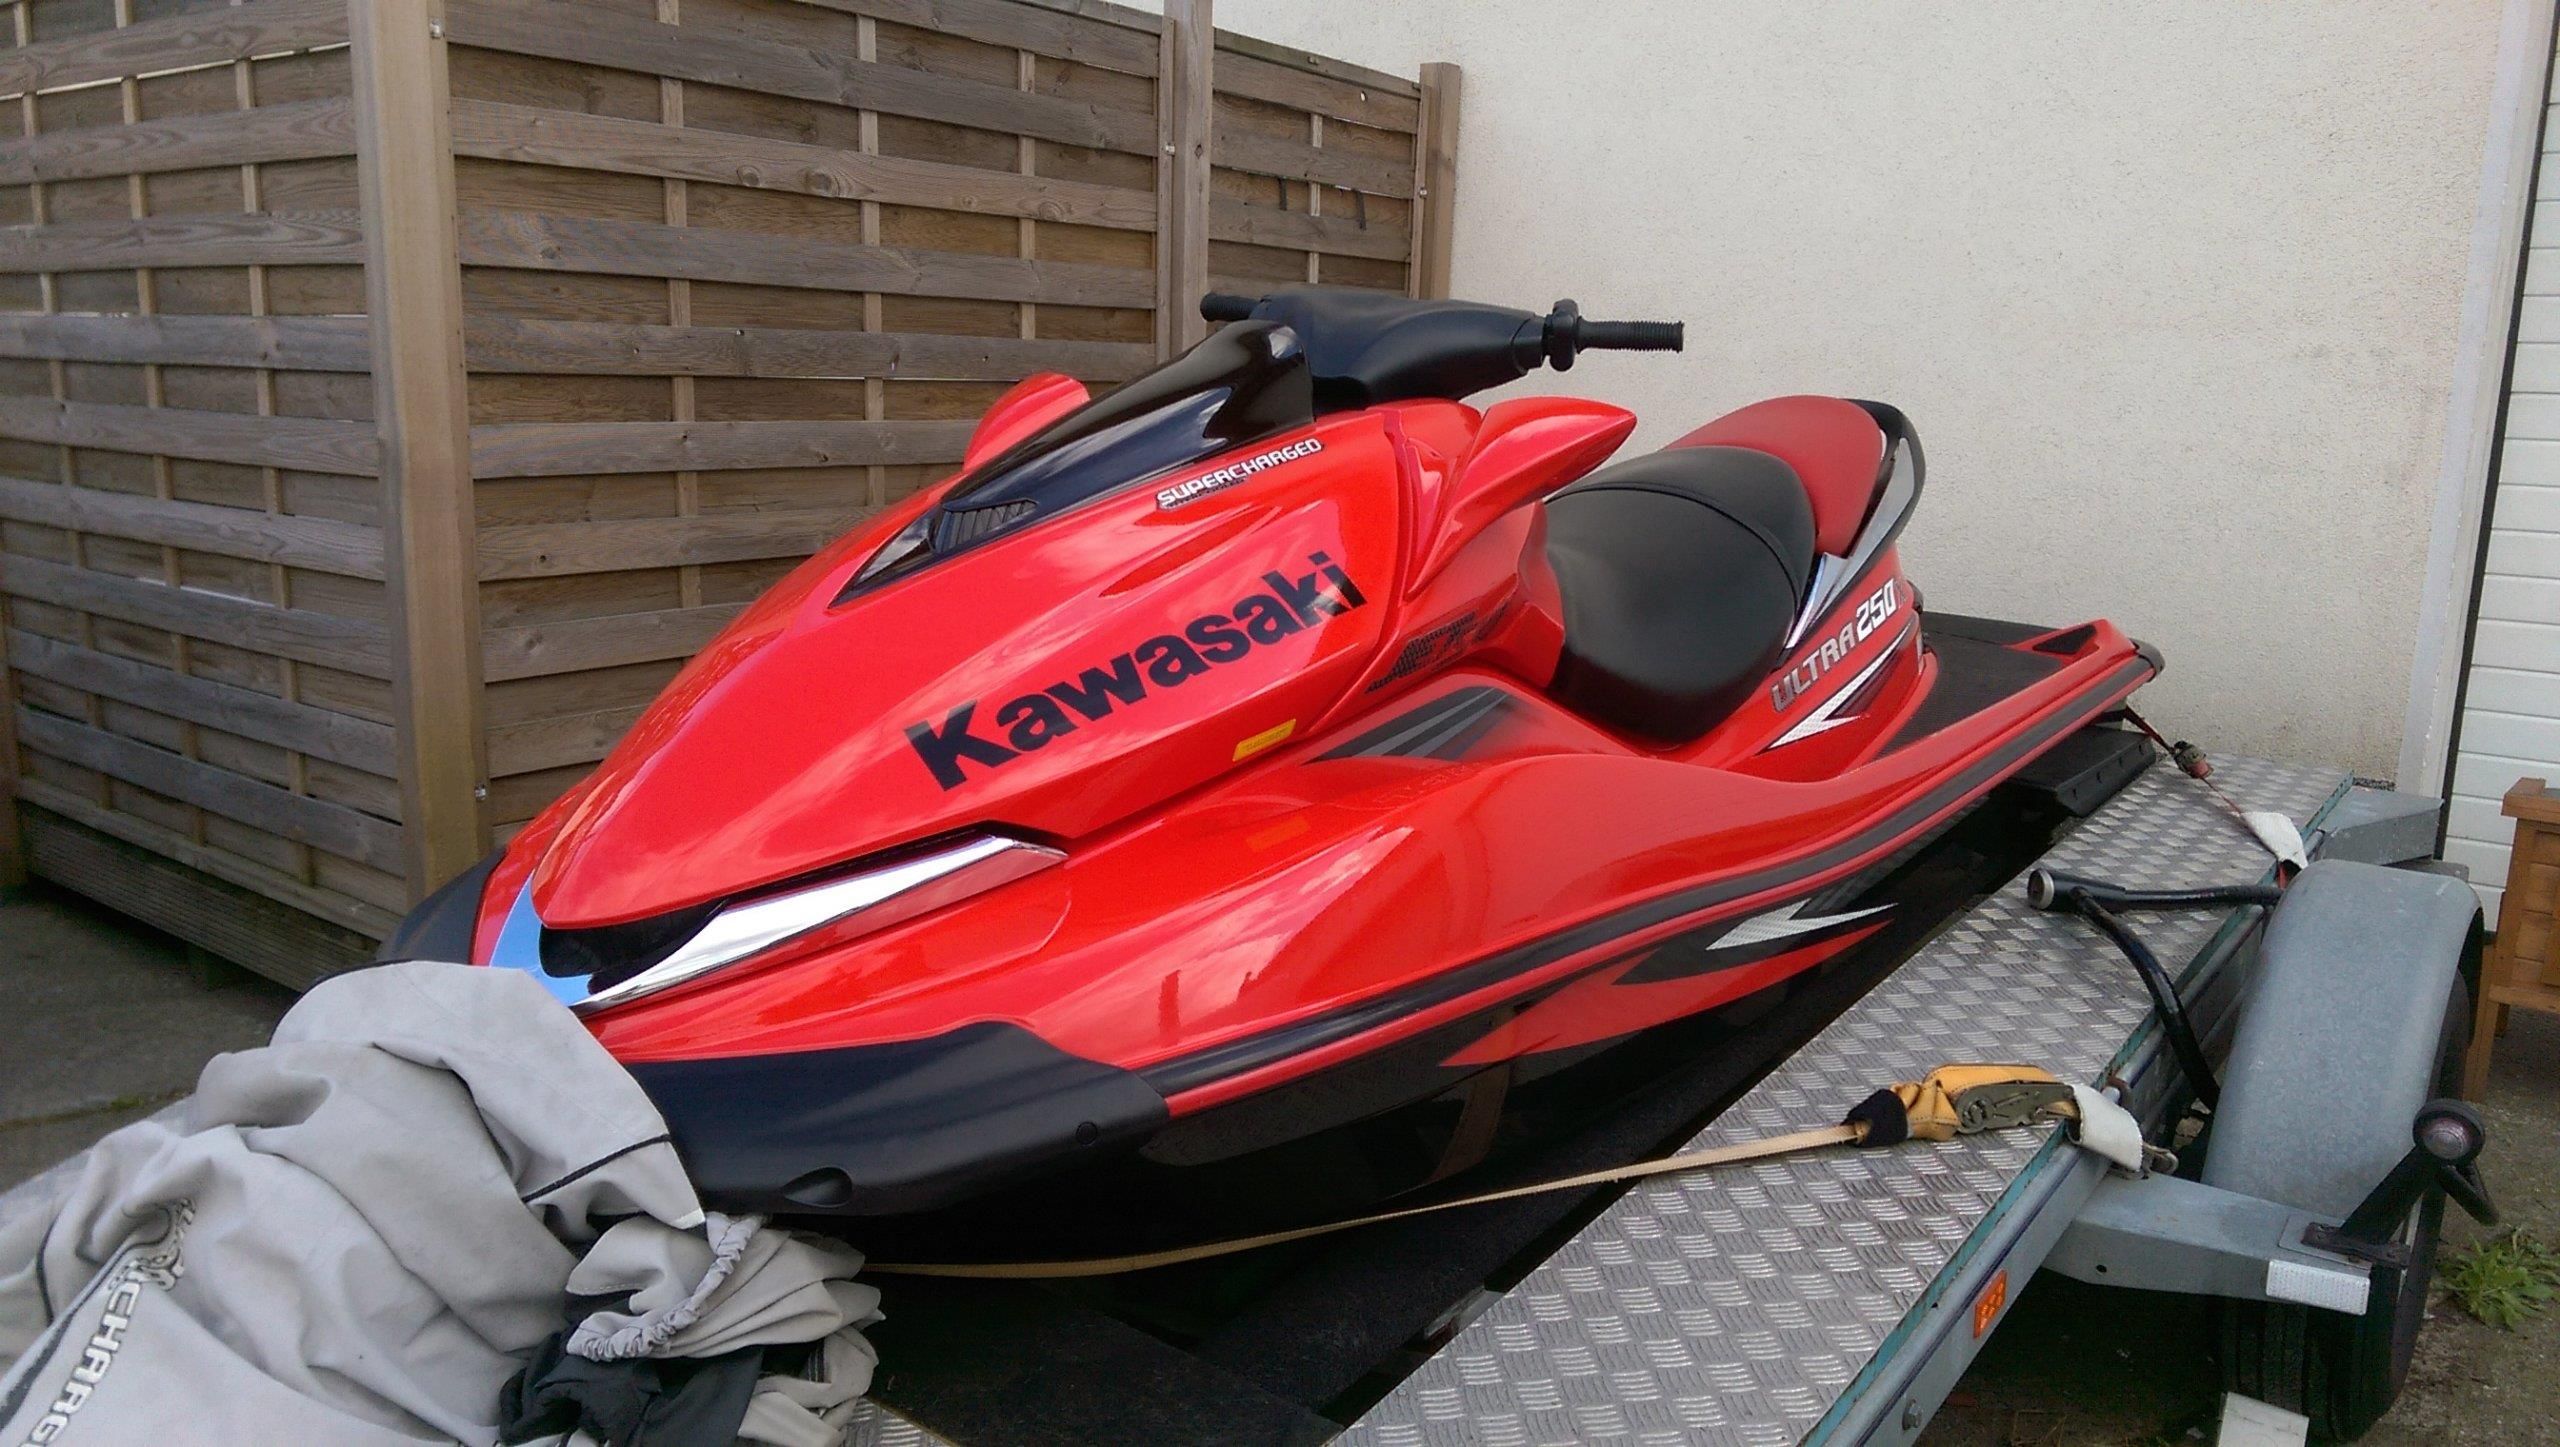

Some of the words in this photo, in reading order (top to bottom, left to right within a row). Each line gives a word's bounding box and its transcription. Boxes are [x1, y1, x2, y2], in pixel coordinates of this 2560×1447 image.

[1157, 438, 1322, 506] SUPERCHARGED
[904, 551, 1367, 792] Kawasaki
[1771, 621, 1855, 712] ULTRA
